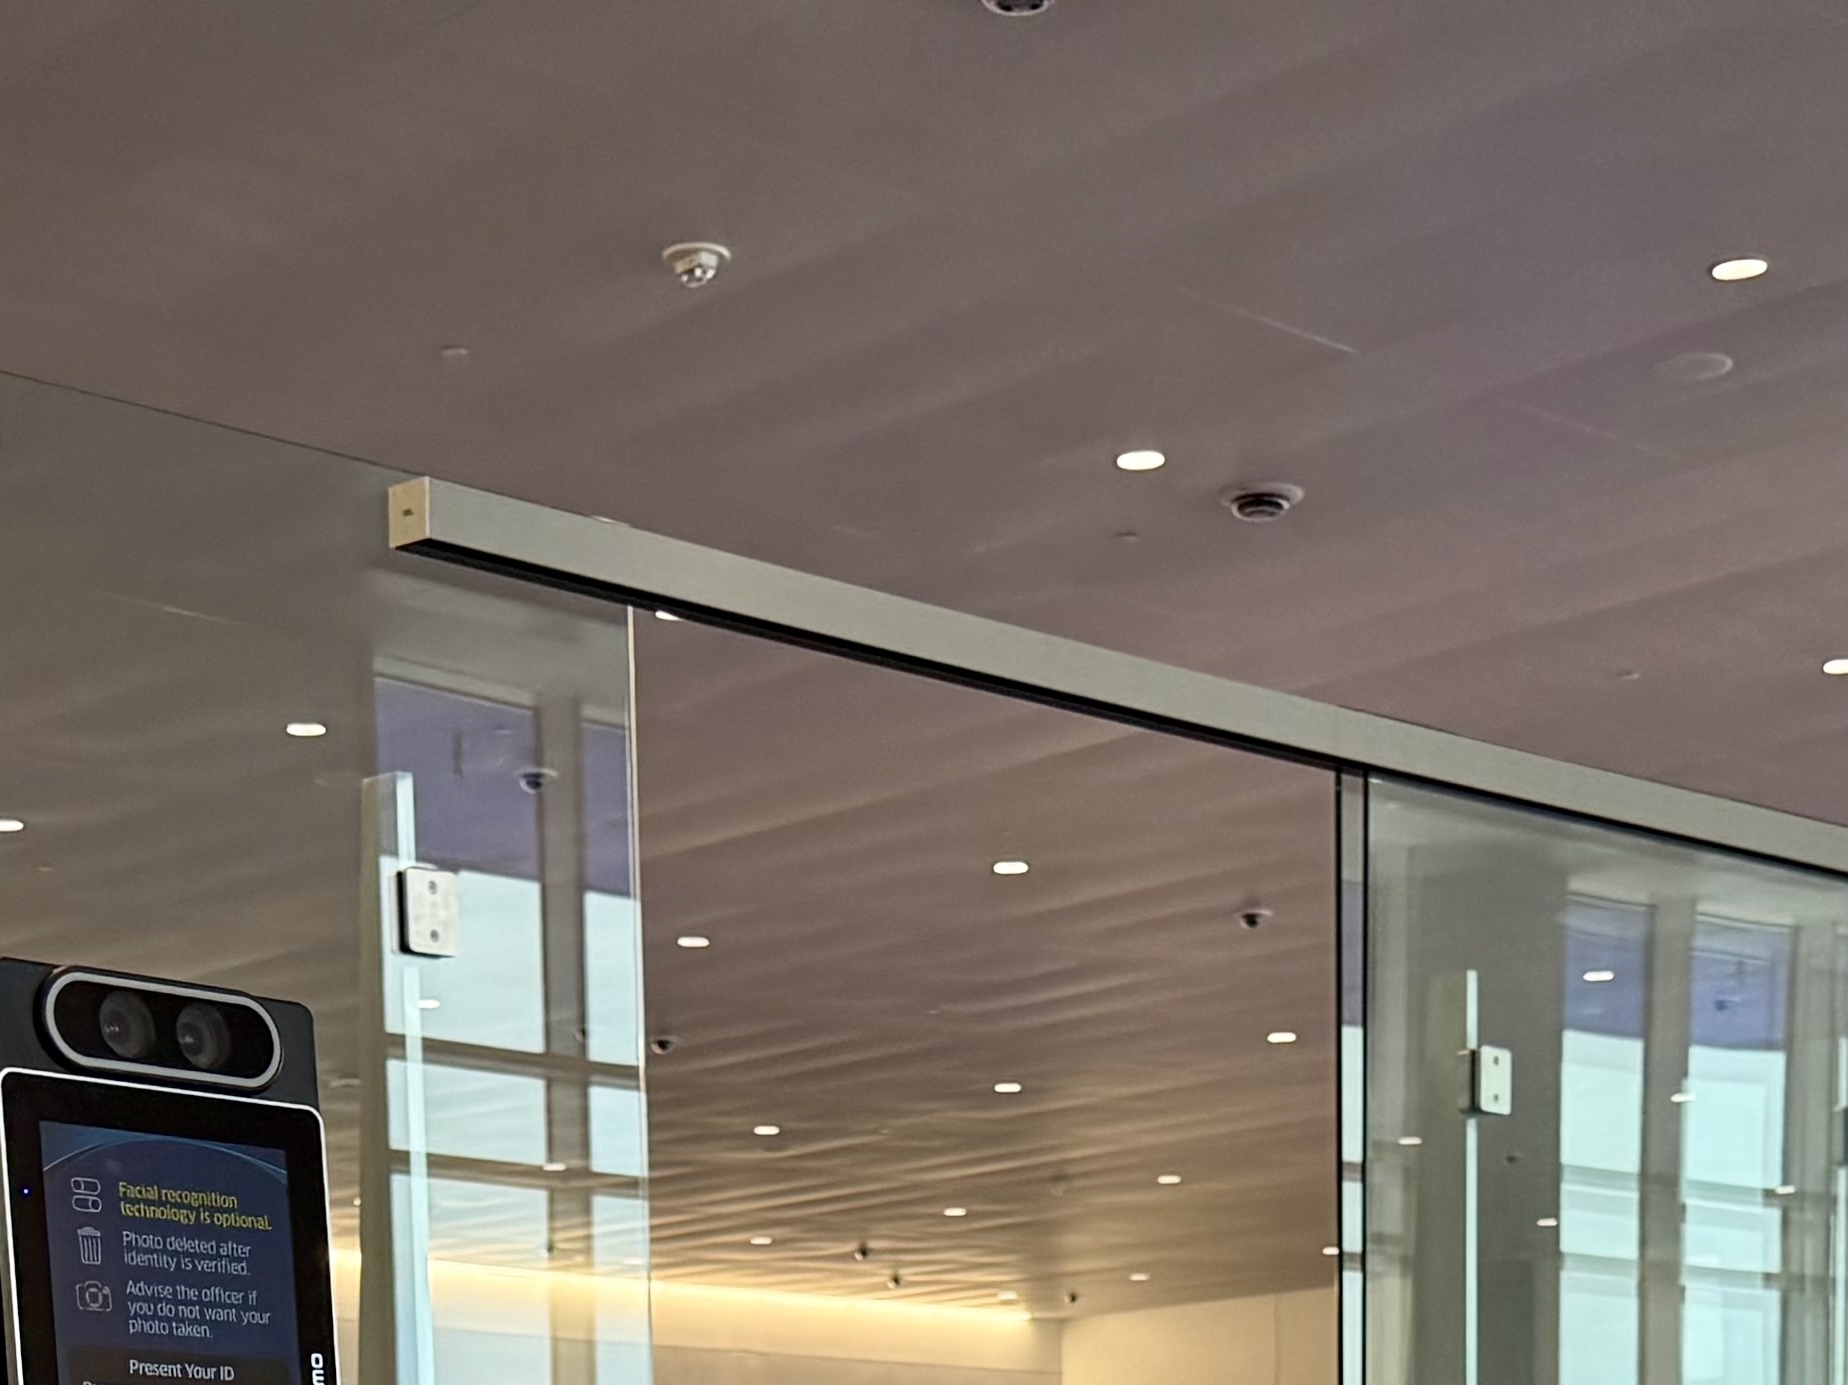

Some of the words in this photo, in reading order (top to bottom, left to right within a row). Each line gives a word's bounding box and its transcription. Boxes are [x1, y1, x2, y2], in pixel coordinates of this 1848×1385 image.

[118, 1181, 158, 1200] Facial
[161, 1188, 238, 1209] recognition
[120, 1200, 197, 1225] technology
[201, 1209, 211, 1223] is
[213, 1211, 272, 1230] optional.
[122, 1231, 164, 1249] Photo
[166, 1234, 216, 1254] deleted
[219, 1240, 252, 1257] after
[123, 1250, 177, 1272] identity
[180, 1255, 192, 1270] is
[195, 1260, 251, 1276] verified.
[126, 1280, 173, 1298] Advise
[176, 1283, 198, 1300] the
[202, 1287, 244, 1304] officer
[247, 1290, 258, 1305] if
[128, 1301, 154, 1316] you
[157, 1301, 175, 1318] do
[178, 1305, 201, 1320] not
[204, 1308, 237, 1322] want
[241, 1311, 271, 1326] your
[128, 1318, 169, 1335] photo
[172, 1321, 213, 1339] taken.
[129, 1359, 182, 1378] Present
[182, 1363, 217, 1380] Your
[219, 1366, 235, 1381] ID
